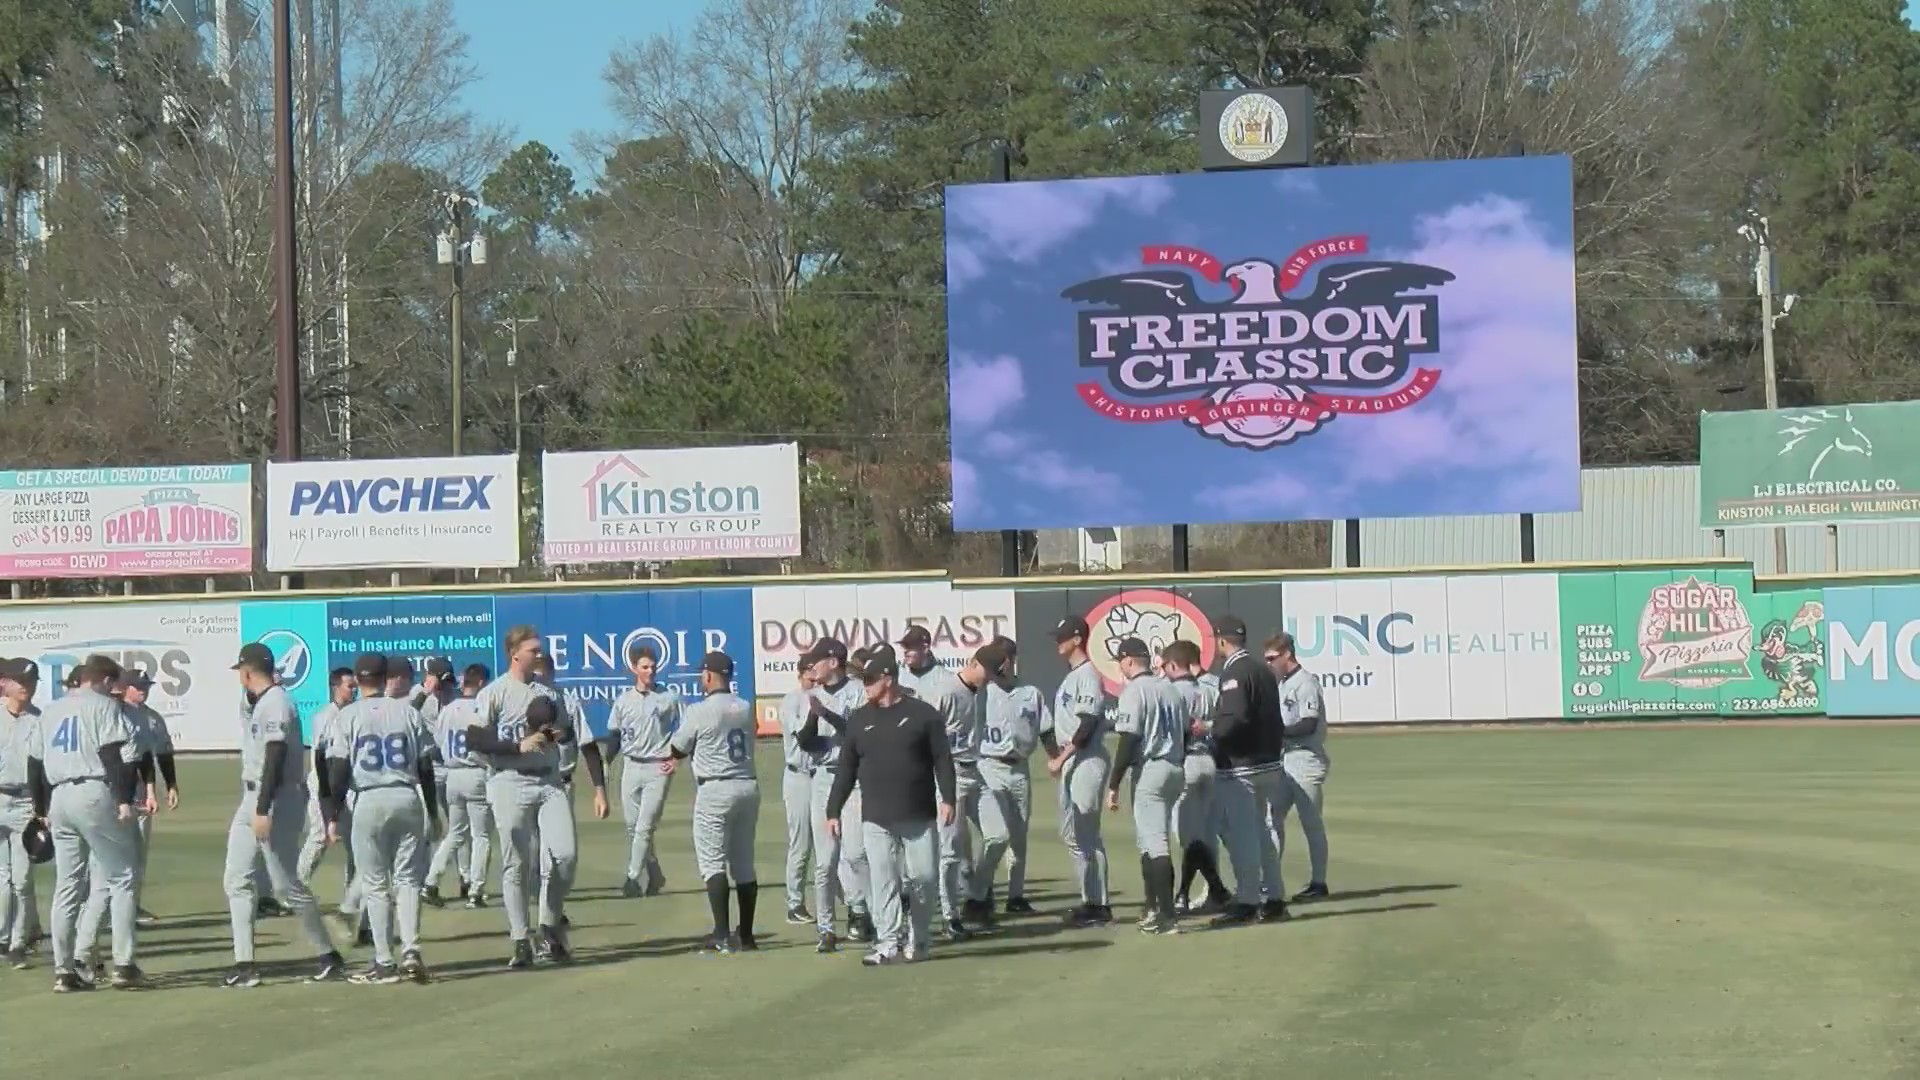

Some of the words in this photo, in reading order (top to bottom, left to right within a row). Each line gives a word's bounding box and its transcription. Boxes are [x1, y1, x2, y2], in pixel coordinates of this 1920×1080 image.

[1158, 249, 1211, 269] NAVY
[1287, 257, 1308, 276] AIR
[1309, 239, 1357, 258] FORCE
[1089, 303, 1427, 358] FREEDOM
[1119, 344, 1396, 390] CLASSIC
[1093, 396, 1188, 419] HISTORIC
[1208, 401, 1311, 420] GRAINGER
[1331, 384, 1423, 410] STADIUM
[16, 471, 40, 486] GET
[43, 471, 52, 485] A
[55, 469, 107, 485] SPECIAL
[111, 468, 148, 483] DEWD
[150, 467, 183, 482] DEAL
[187, 466, 232, 480] TODAY!
[154, 491, 188, 500] PIZZA
[290, 475, 495, 516] PAYCHEX
[601, 481, 760, 515] Kinston
[1753, 485, 1772, 497] LJ
[1776, 479, 1871, 496] ELECTRICAL
[1875, 479, 1900, 491] CO.
[14, 493, 32, 506] ANY
[34, 492, 63, 505] LARGE
[65, 491, 90, 504] PIZZA
[13, 510, 51, 524] DESSERT
[61, 510, 66, 522] 2
[68, 509, 91, 522] LITER
[1718, 506, 1773, 520] KINSTON
[1785, 503, 1840, 516] RALEIGH
[1851, 498, 1920, 512] WILMINGT
[105, 506, 162, 544] PAPA
[167, 504, 239, 543] JOHNS
[289, 529, 306, 540] HR
[317, 527, 358, 540] Payroll
[369, 525, 419, 536] Benefits
[430, 524, 492, 534] Insurance
[602, 521, 679, 535] REALTY
[690, 519, 761, 532] GROUP
[12, 527, 40, 548] ONLY
[41, 525, 93, 544] $19.99
[549, 542, 580, 555] VOTED
[598, 540, 623, 553] REAL
[626, 539, 659, 552] ESTATE
[663, 539, 697, 551] GROUP
[714, 538, 751, 550] LENOIR
[755, 536, 794, 548] COUNTY
[70, 555, 108, 568] DEWD
[1653, 588, 1736, 609] SUGAR
[160, 616, 197, 625] Camera
[199, 615, 238, 624] Systems
[186, 626, 203, 634] Fire
[206, 624, 238, 634] Alarms
[332, 616, 349, 630] Big
[352, 618, 363, 627] or
[364, 616, 392, 627] small
[394, 616, 409, 624] we
[412, 614, 442, 624] insure
[445, 613, 473, 623] them
[475, 613, 492, 623] all!
[1576, 624, 1615, 636] PIZZA
[1670, 613, 1721, 632] HILL
[26, 632, 60, 640] Control
[330, 639, 357, 652] The
[361, 637, 434, 651] Insurance
[439, 634, 493, 650] Market
[761, 616, 890, 652] DOWN
[1287, 612, 1415, 657] UNC
[1423, 632, 1548, 654] HEALTH
[1577, 638, 1613, 649] SUBS
[545, 627, 737, 674] ENOIR
[1578, 651, 1631, 663] SALADS
[1659, 638, 1734, 663] Pizzeria
[1312, 666, 1373, 688] noir
[1578, 665, 1613, 677] APPS
[1572, 699, 1716, 715] sugarhill-pizzeria.com
[52, 715, 78, 753] 41
[448, 729, 468, 758] 18
[356, 732, 408, 771] 38
[727, 728, 746, 762] 8
